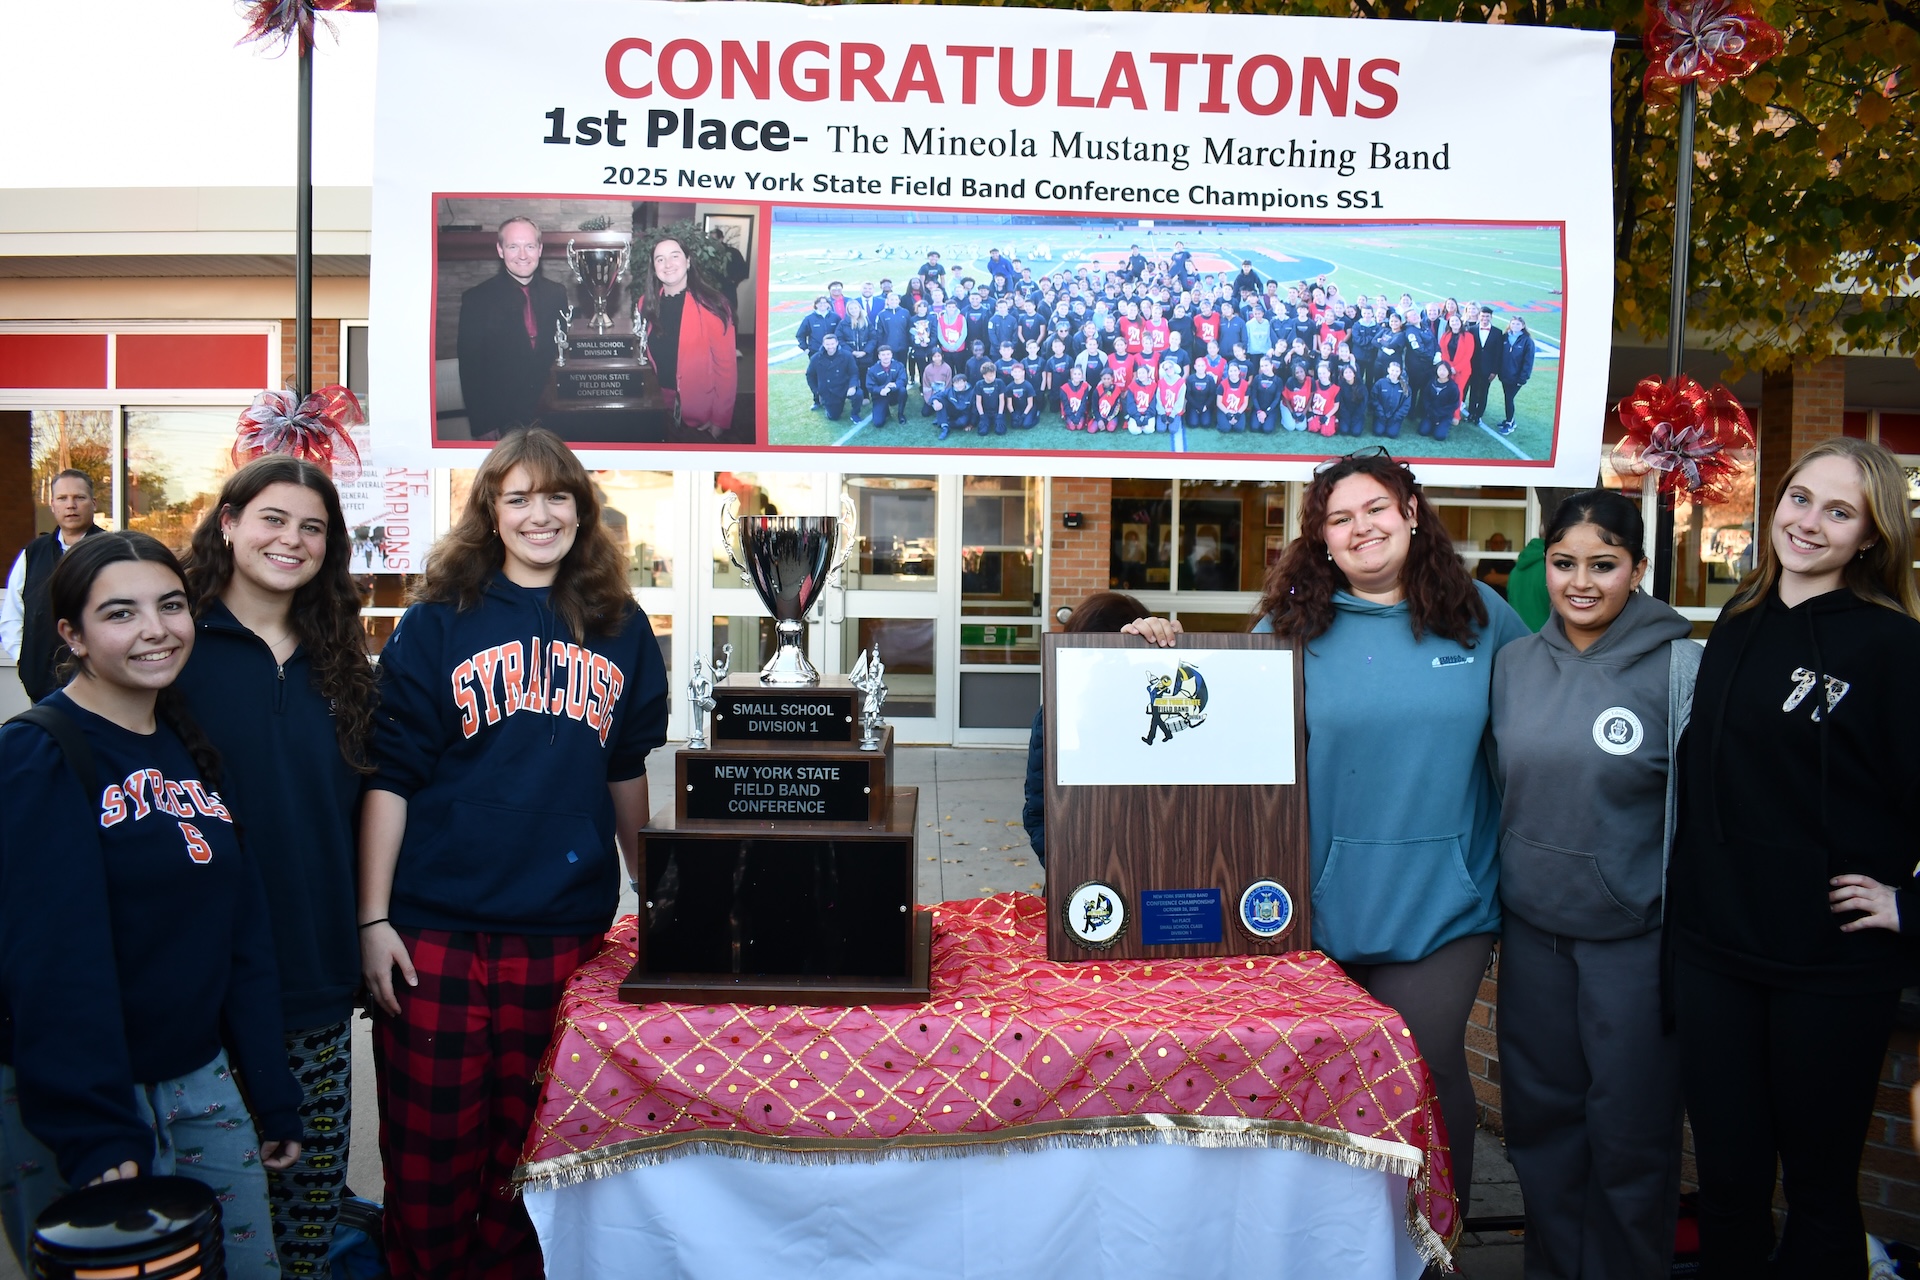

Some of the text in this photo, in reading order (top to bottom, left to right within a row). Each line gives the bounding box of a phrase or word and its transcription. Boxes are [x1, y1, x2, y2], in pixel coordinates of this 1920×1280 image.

[604, 37, 1401, 119] CONGRATULATIONS
[543, 107, 1450, 176] 1st Place- The Mineola Mustang Marching Band
[603, 166, 1384, 212] 2025 New York State Field Band Conference Champions SS1
[451, 636, 625, 749] SYRACUSE
[732, 703, 835, 716] SMALL SCHOOL
[748, 720, 819, 733] DIVISION 1
[714, 766, 840, 780] NEW YORK STATE
[734, 783, 821, 797] FIELD BAND
[728, 800, 826, 814] CONFERENCE
[178, 821, 212, 864] S
